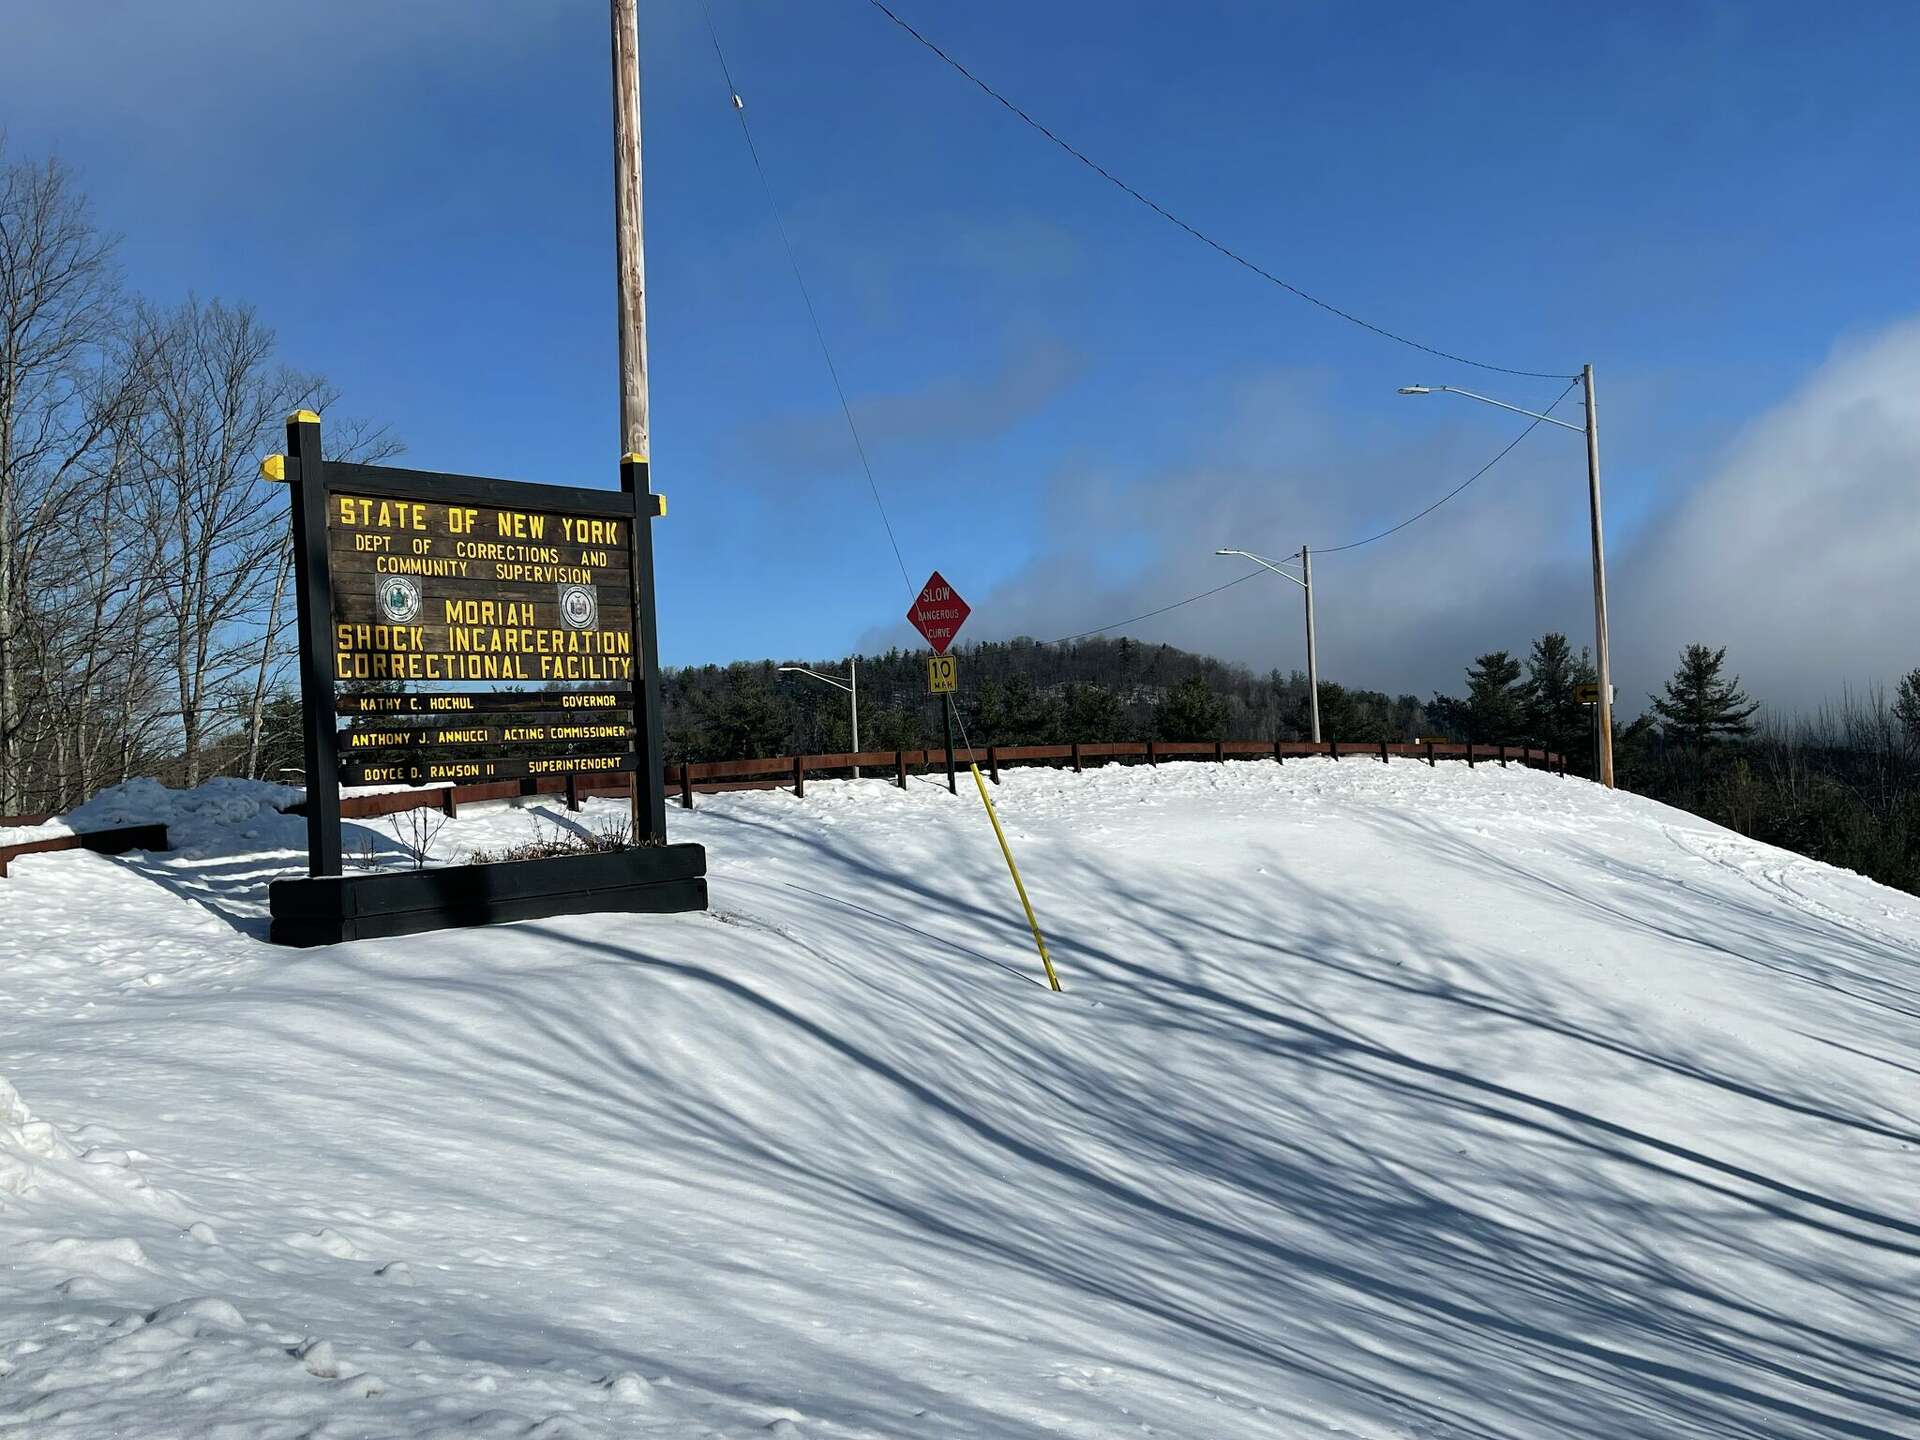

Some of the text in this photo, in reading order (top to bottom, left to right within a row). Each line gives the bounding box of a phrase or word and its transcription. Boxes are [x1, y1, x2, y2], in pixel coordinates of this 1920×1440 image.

[340, 498, 617, 545] STATE OF NEW YORK
[355, 534, 607, 567] DEPT OF CORRECTIONS AND
[376, 556, 592, 585] COMMUNITY SUPERVISION
[923, 587, 950, 602] SLOW
[444, 599, 535, 627] MORIAH
[918, 608, 959, 622] DANGEROUS
[337, 624, 630, 654] SHOCK INCARCERATION
[928, 627, 951, 640] CURVE
[336, 653, 631, 679] CORRECTIONAL FACILITY
[932, 660, 951, 679] 10
[360, 697, 474, 711] KATHY C. HOCHUL
[562, 695, 617, 708] GOVERNOR
[351, 729, 489, 747] ANTHONY J. ANNUCCI
[504, 726, 626, 741] ACTING COMMISSIONER
[410, 766, 423, 779] D.
[430, 764, 480, 778] RAWSON
[486, 764, 495, 776] II
[528, 757, 622, 774] SUPERINTENDENT
